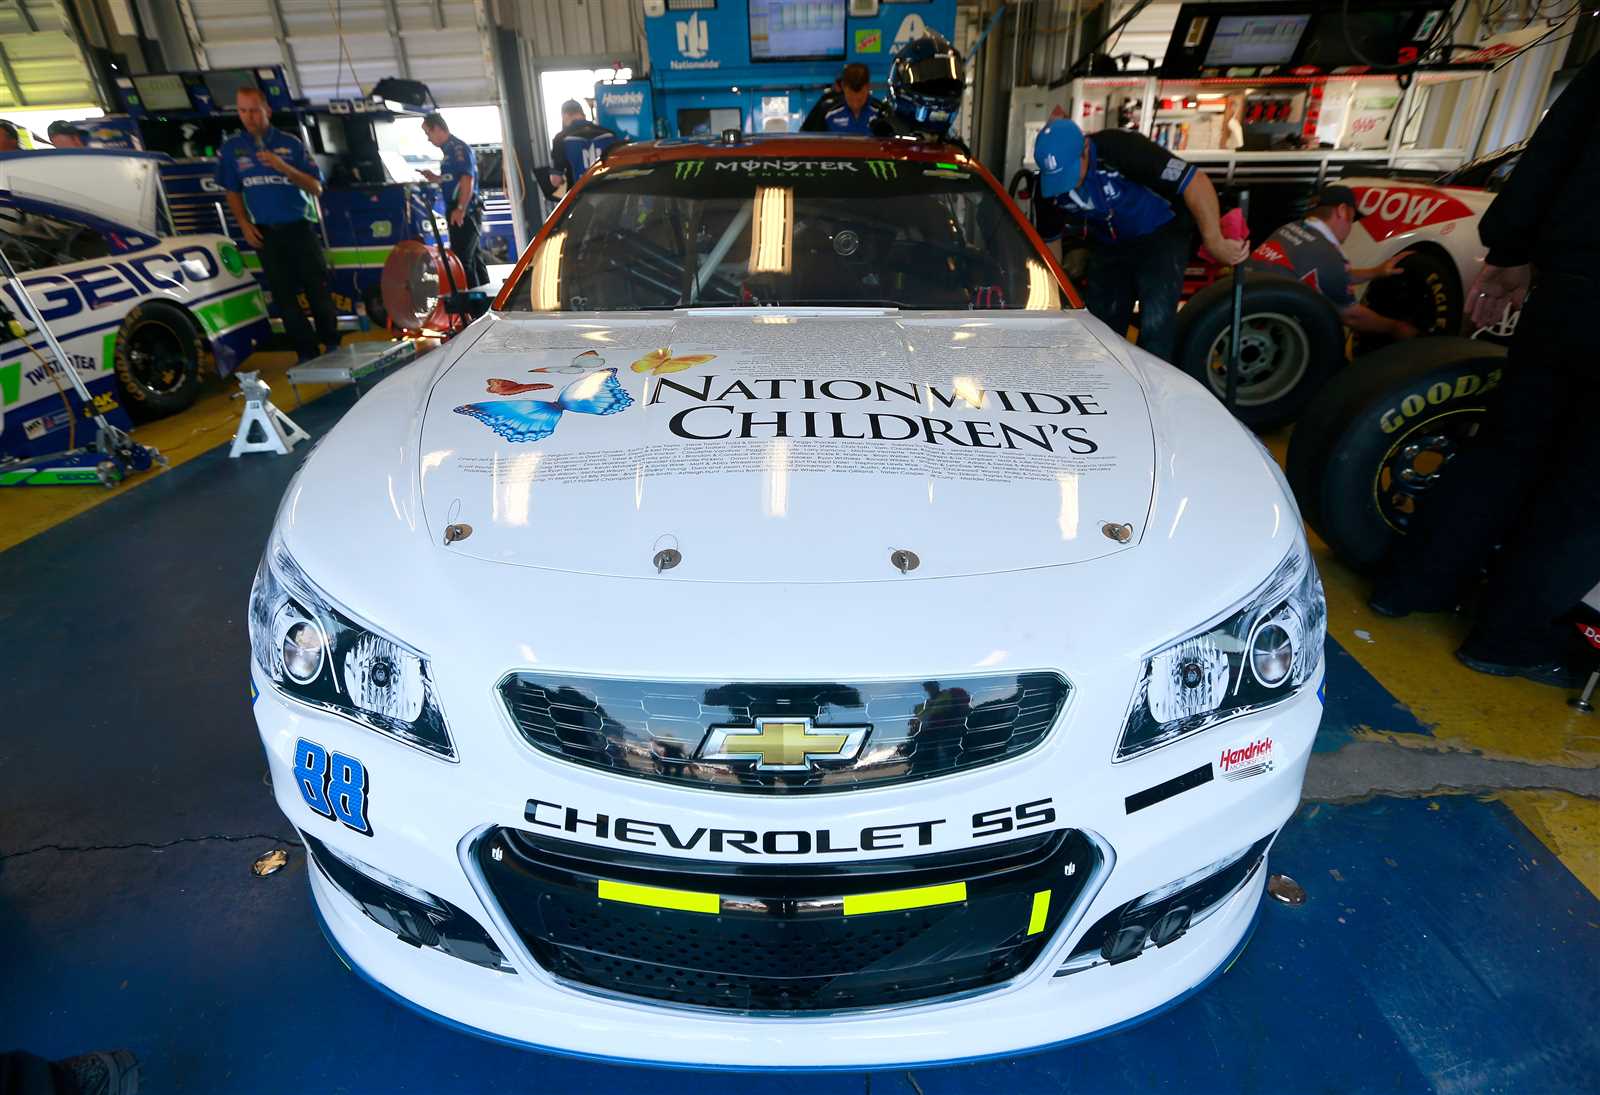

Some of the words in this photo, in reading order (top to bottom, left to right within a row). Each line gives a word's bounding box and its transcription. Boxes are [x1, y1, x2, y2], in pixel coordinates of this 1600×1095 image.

[670, 60, 720, 70] Nationwide
[603, 91, 644, 107] Hendrick
[715, 160, 859, 173] MONSTER
[1358, 187, 1448, 226] DOW
[2, 245, 219, 322] GEICO
[1425, 272, 1447, 329] EAGLE
[24, 357, 75, 386] TWISTD
[73, 354, 97, 371] TEA
[650, 375, 1108, 416] NATIONWIDE
[669, 405, 1099, 454] CHILDREN'S
[1219, 736, 1273, 772] Hendrick
[293, 737, 374, 838] 88
[523, 798, 947, 856] CHEVROLET
[972, 797, 1056, 839] SS
